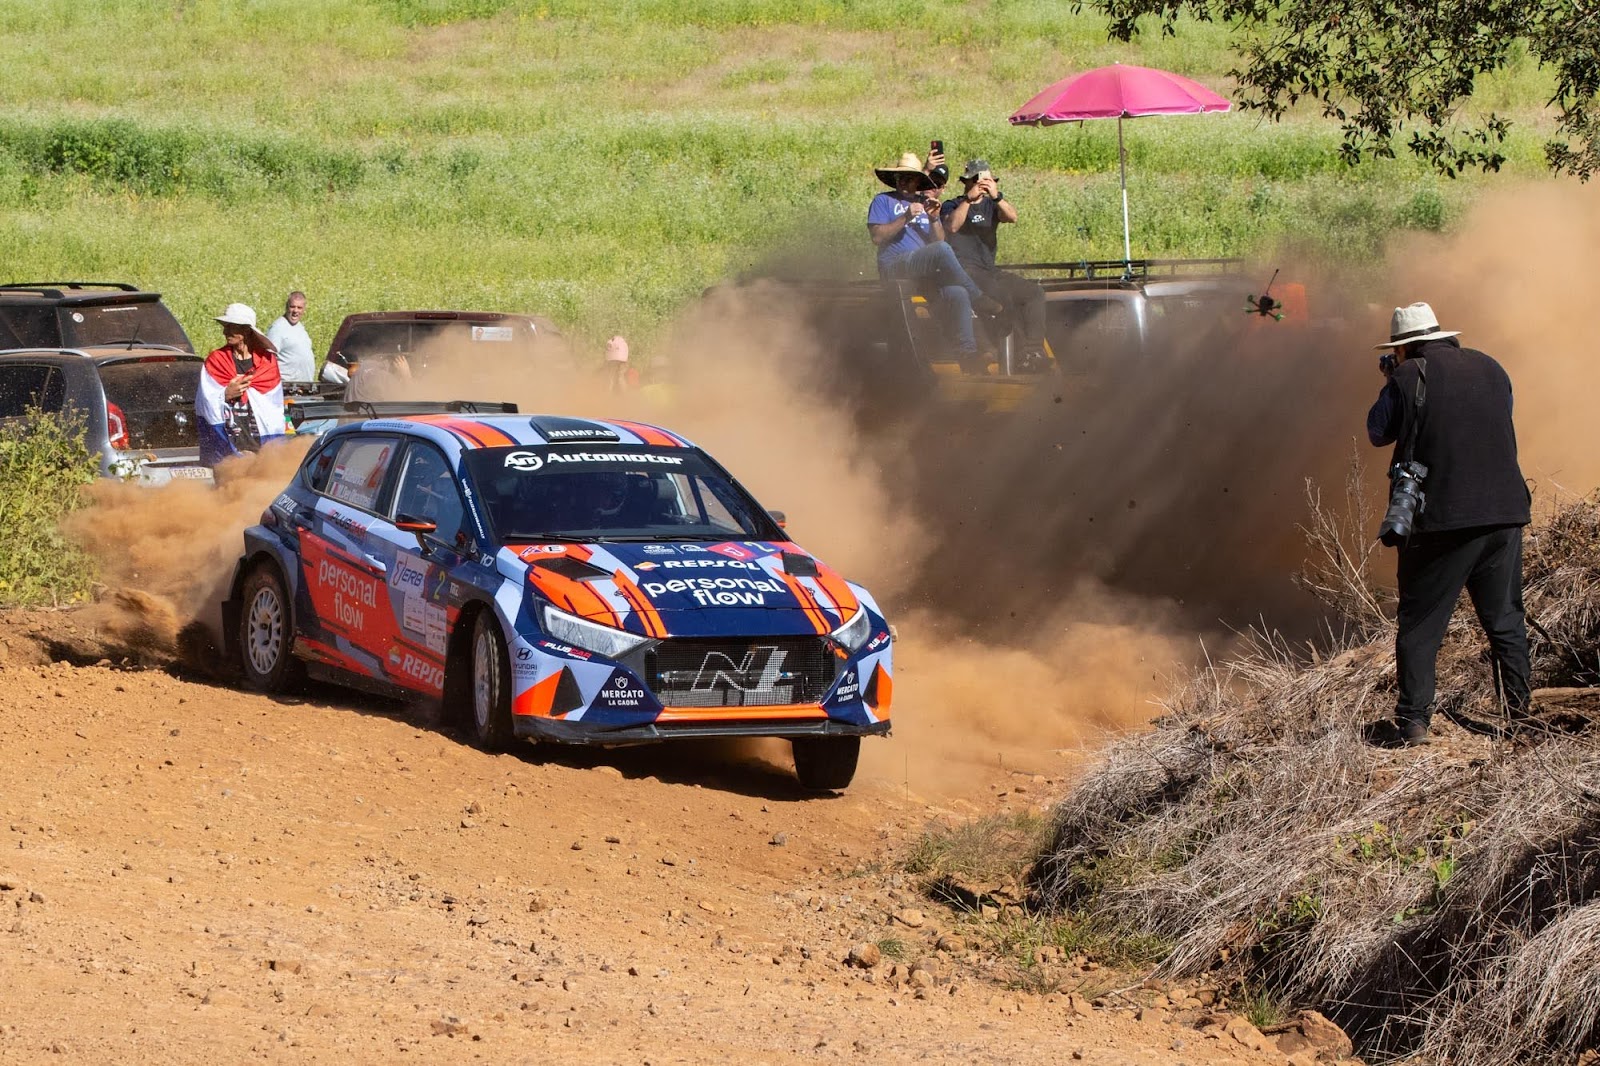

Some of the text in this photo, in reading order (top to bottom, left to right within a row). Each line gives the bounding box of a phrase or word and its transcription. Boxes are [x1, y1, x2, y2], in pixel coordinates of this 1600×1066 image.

[547, 453, 683, 465] Automotor
[663, 560, 761, 570] REPSOL
[319, 560, 378, 608] personal
[433, 570, 446, 600] 2
[643, 579, 786, 598] personal
[693, 589, 765, 605] flow
[335, 591, 363, 631] flow
[544, 642, 592, 659] PLUSCAR
[402, 654, 445, 690] REPSO
[601, 690, 645, 699] MERCATO
[837, 684, 859, 696] MERCATO
